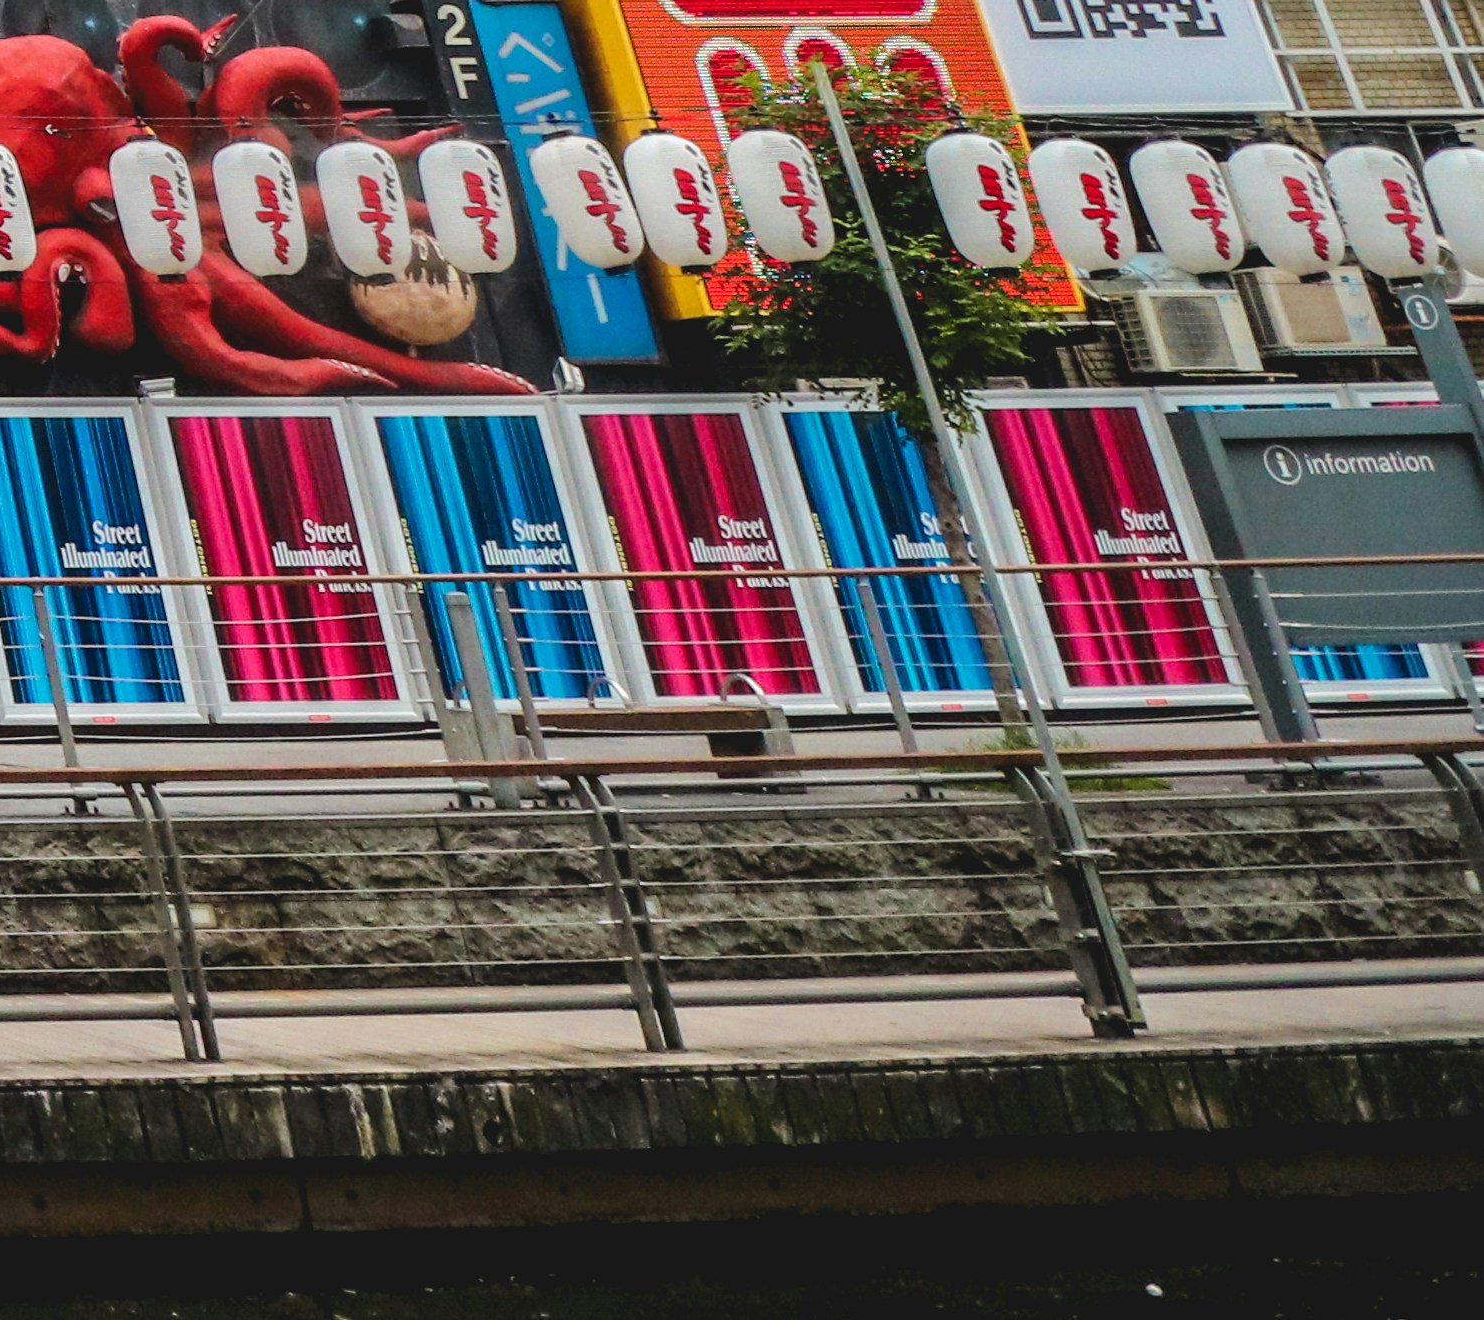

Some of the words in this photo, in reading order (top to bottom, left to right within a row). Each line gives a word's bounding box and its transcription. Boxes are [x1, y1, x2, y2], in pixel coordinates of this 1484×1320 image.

[1303, 451, 1436, 475] information
[92, 520, 142, 545] Street
[301, 518, 352, 544] Street
[511, 517, 562, 543] Street
[717, 514, 768, 540] Street
[1120, 507, 1170, 533] Street
